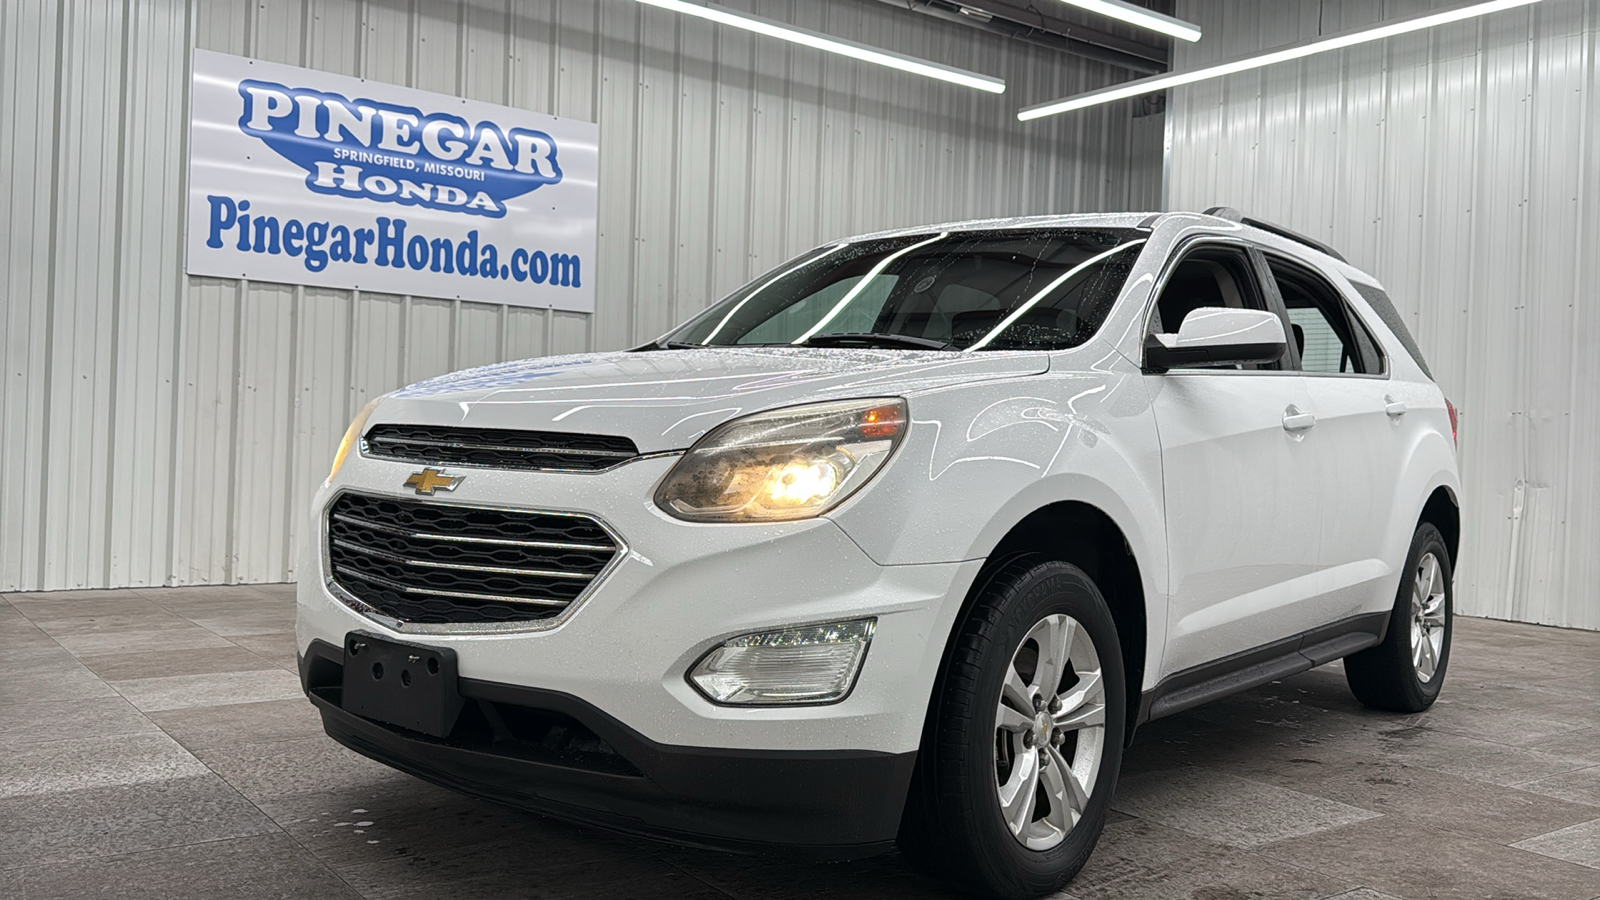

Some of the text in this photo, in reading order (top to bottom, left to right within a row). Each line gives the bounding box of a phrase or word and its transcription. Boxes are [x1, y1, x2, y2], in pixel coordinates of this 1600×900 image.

[246, 86, 557, 178] PINEGAR
[333, 147, 485, 182] SPRINGFIELD, MISSOURI
[313, 160, 500, 212] HONDA
[206, 194, 581, 288] PinegarHonda.com
